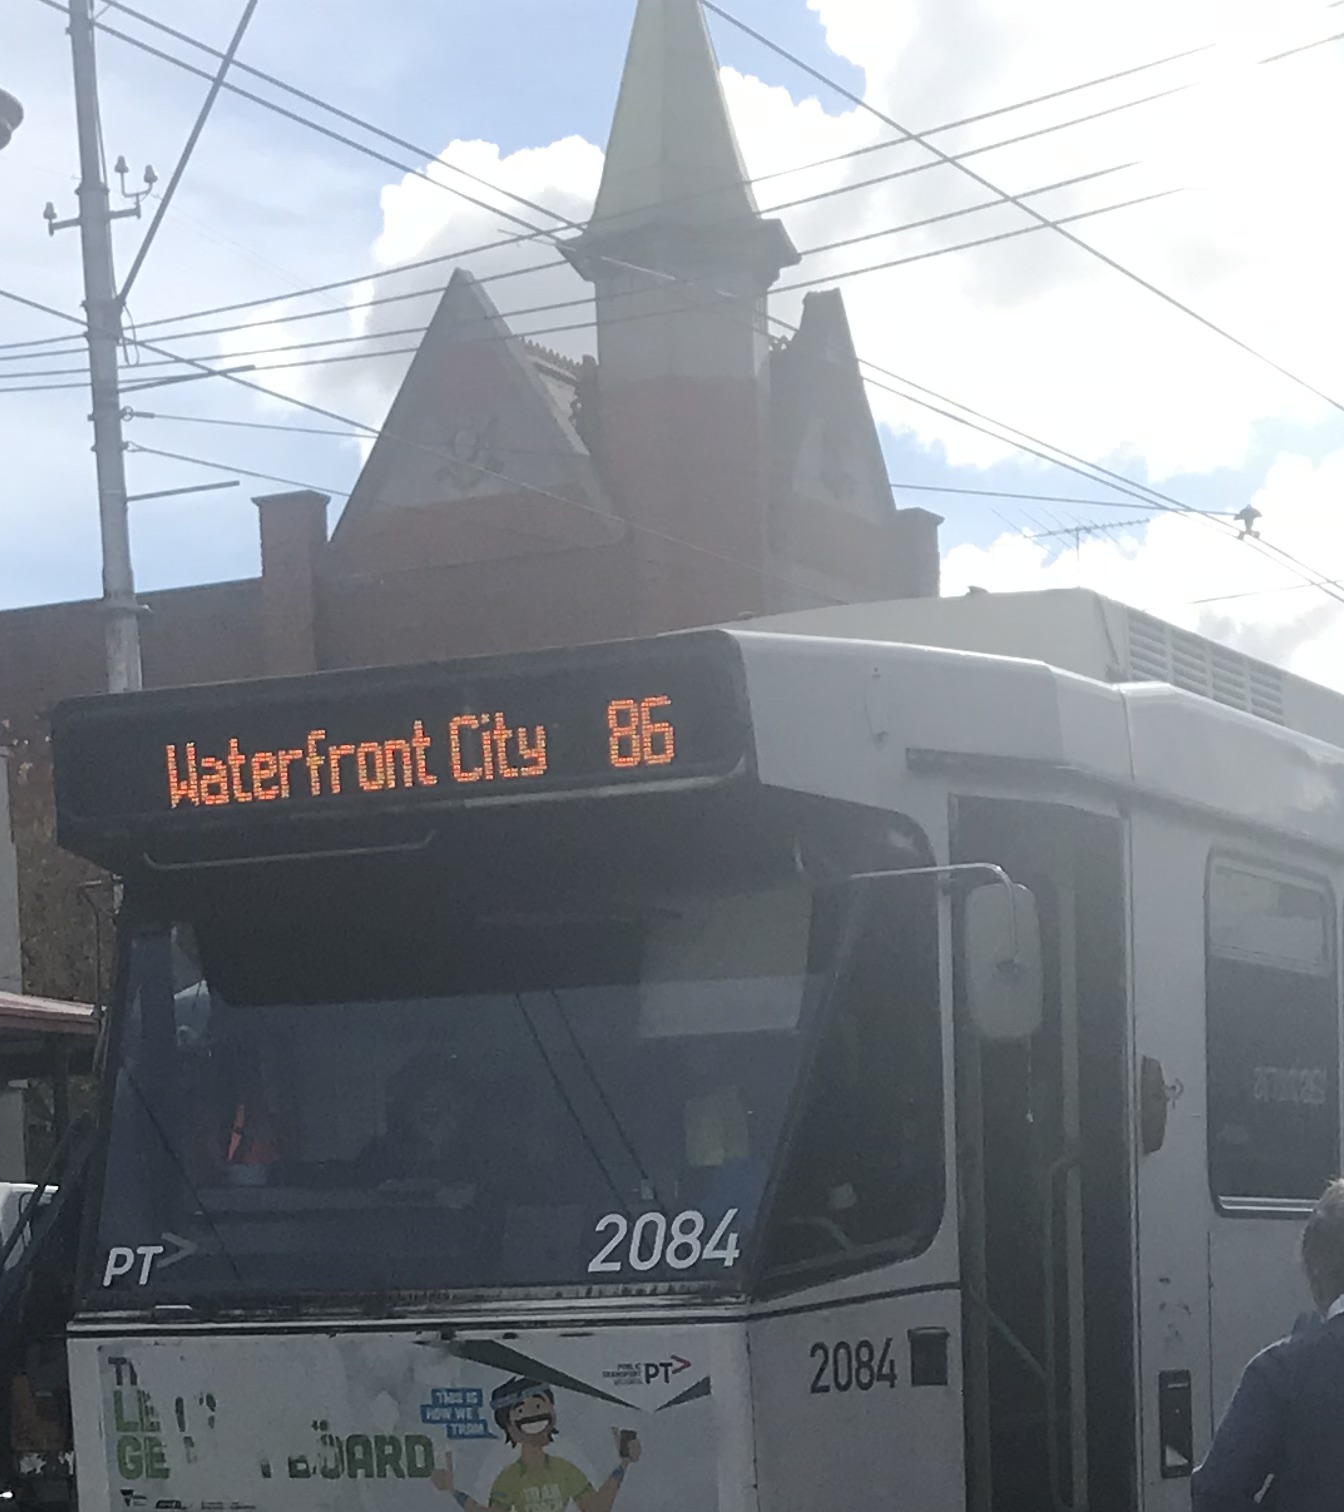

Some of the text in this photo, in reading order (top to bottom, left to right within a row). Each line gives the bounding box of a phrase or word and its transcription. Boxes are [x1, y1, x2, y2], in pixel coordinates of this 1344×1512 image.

[165, 695, 675, 808] Waterfront City 86
[588, 1208, 740, 1272] 2084
[809, 1337, 898, 1394] 2084
